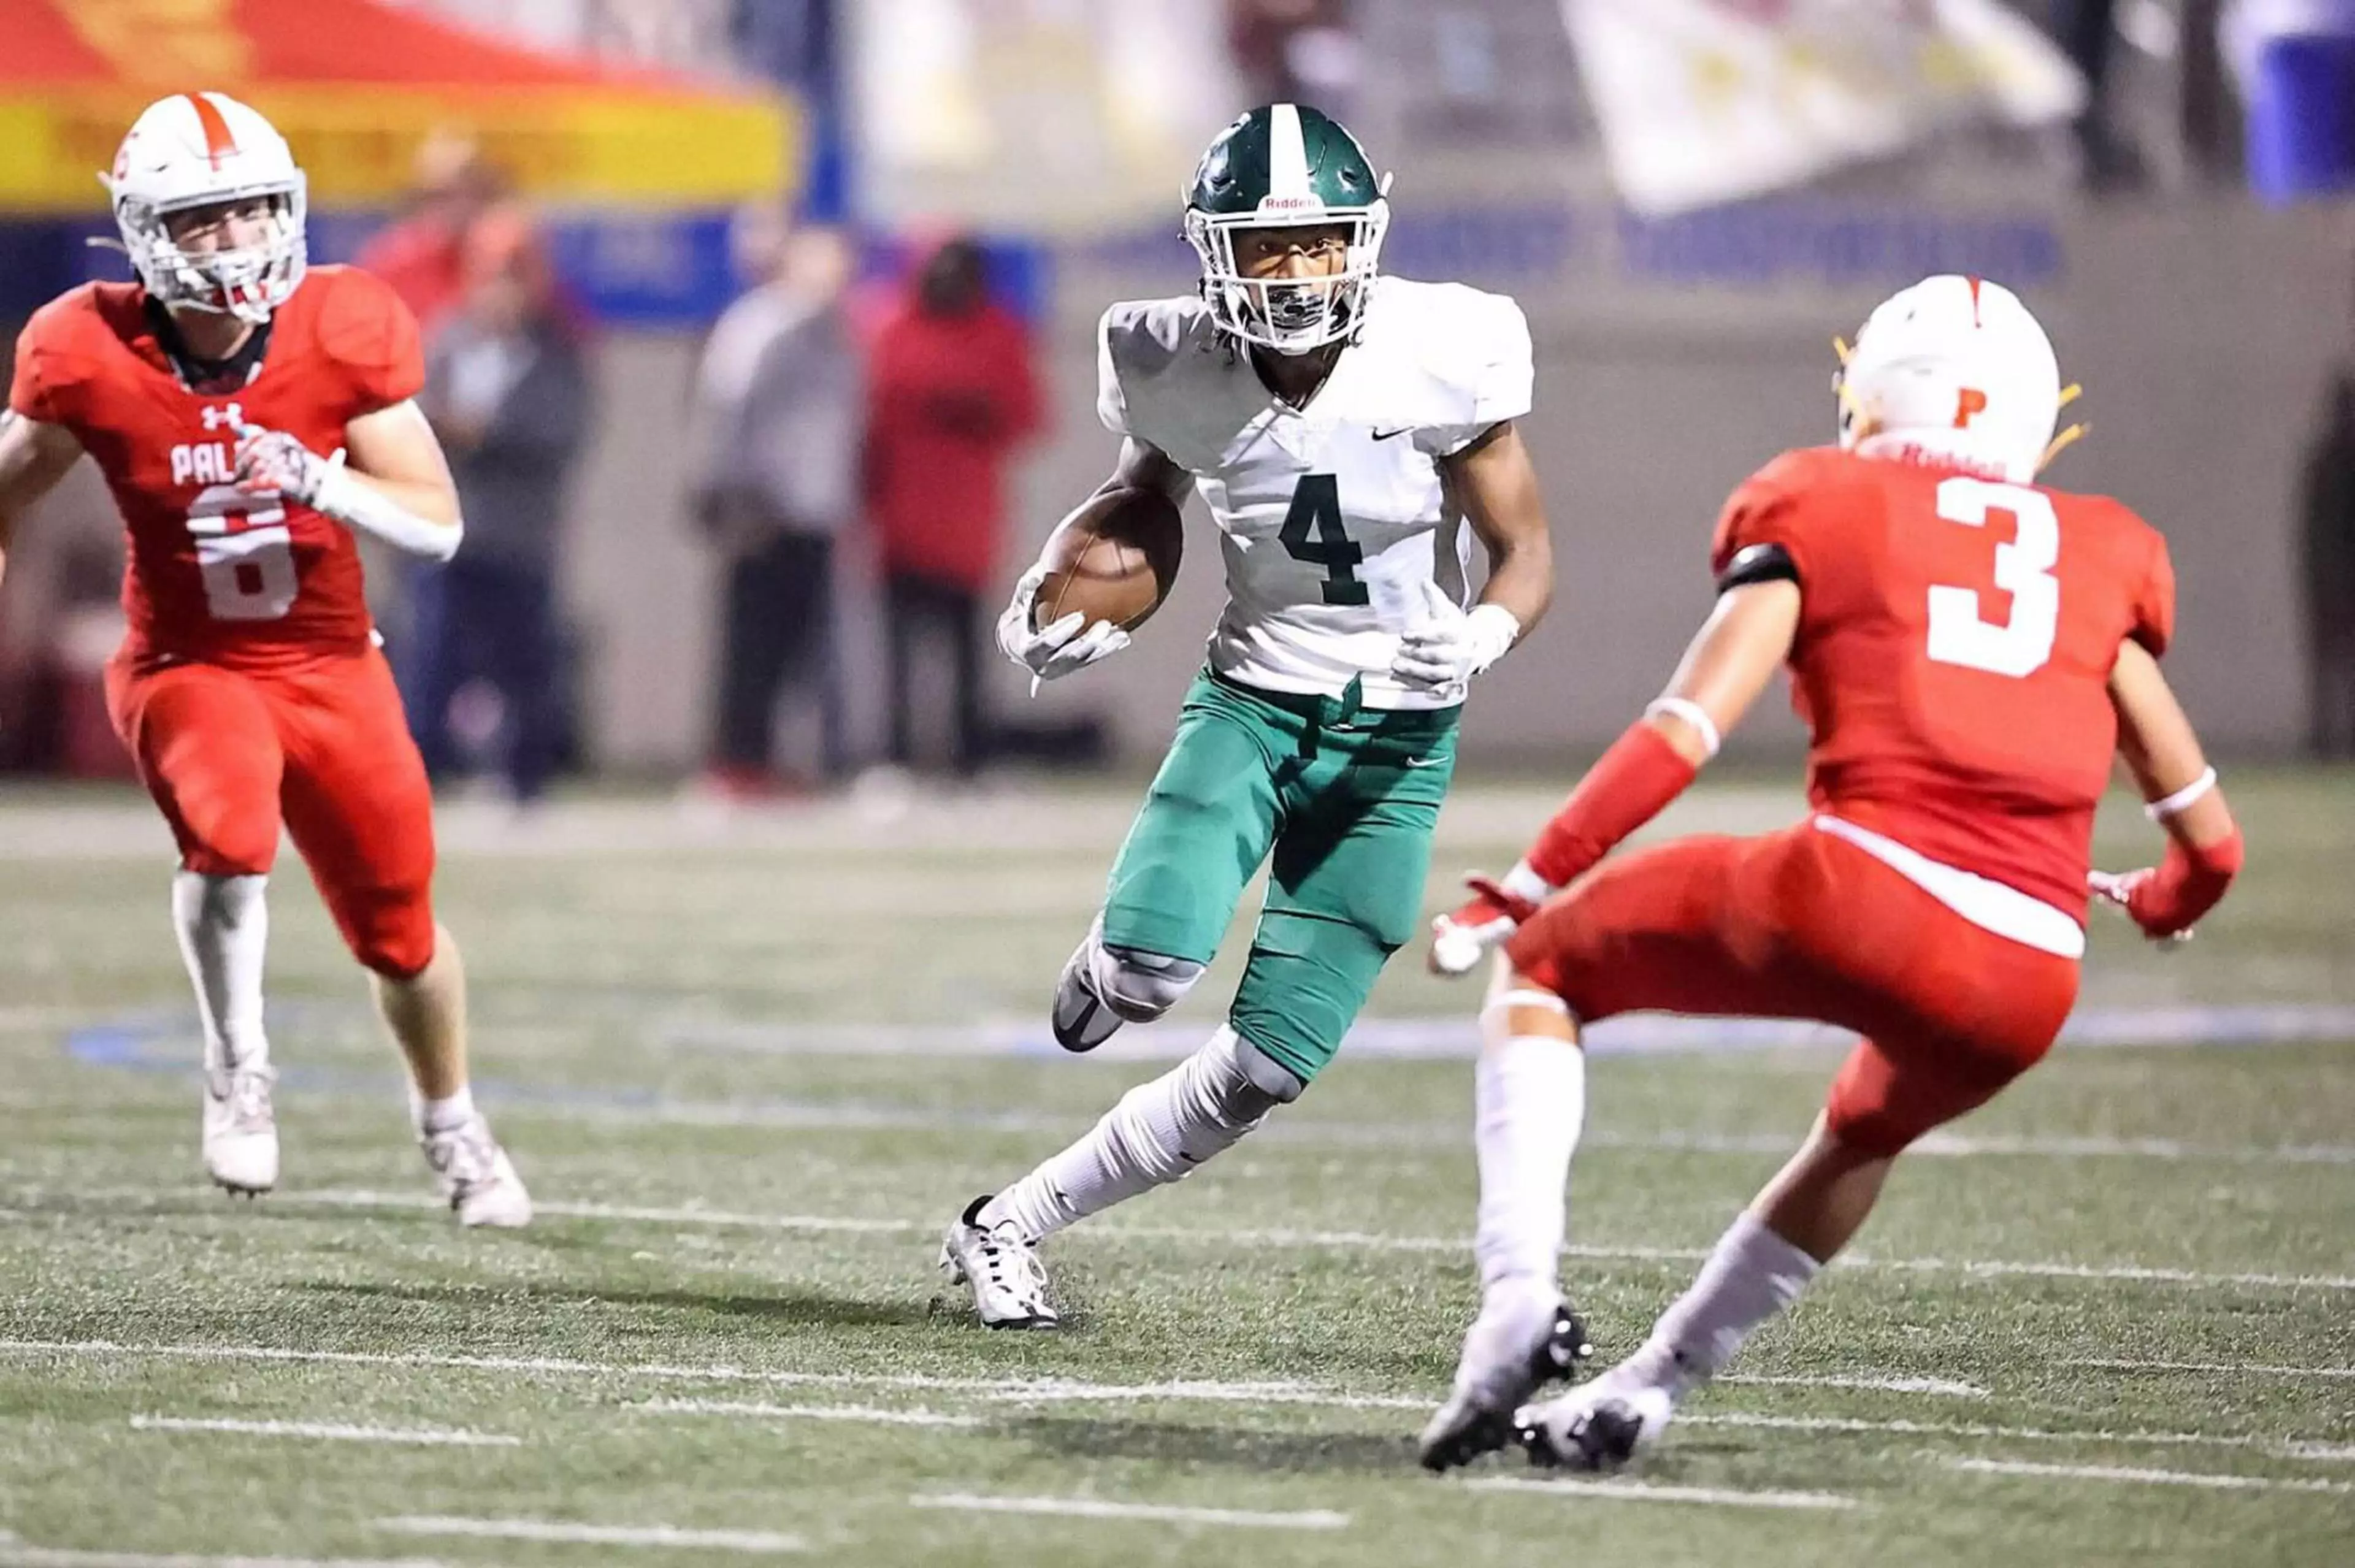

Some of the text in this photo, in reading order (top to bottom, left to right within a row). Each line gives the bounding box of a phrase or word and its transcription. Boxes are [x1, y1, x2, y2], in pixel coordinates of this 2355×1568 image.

[1953, 388, 1988, 428] P
[170, 442, 245, 484] PAL
[1278, 474, 1369, 605] 4
[1928, 476, 2059, 678] 3
